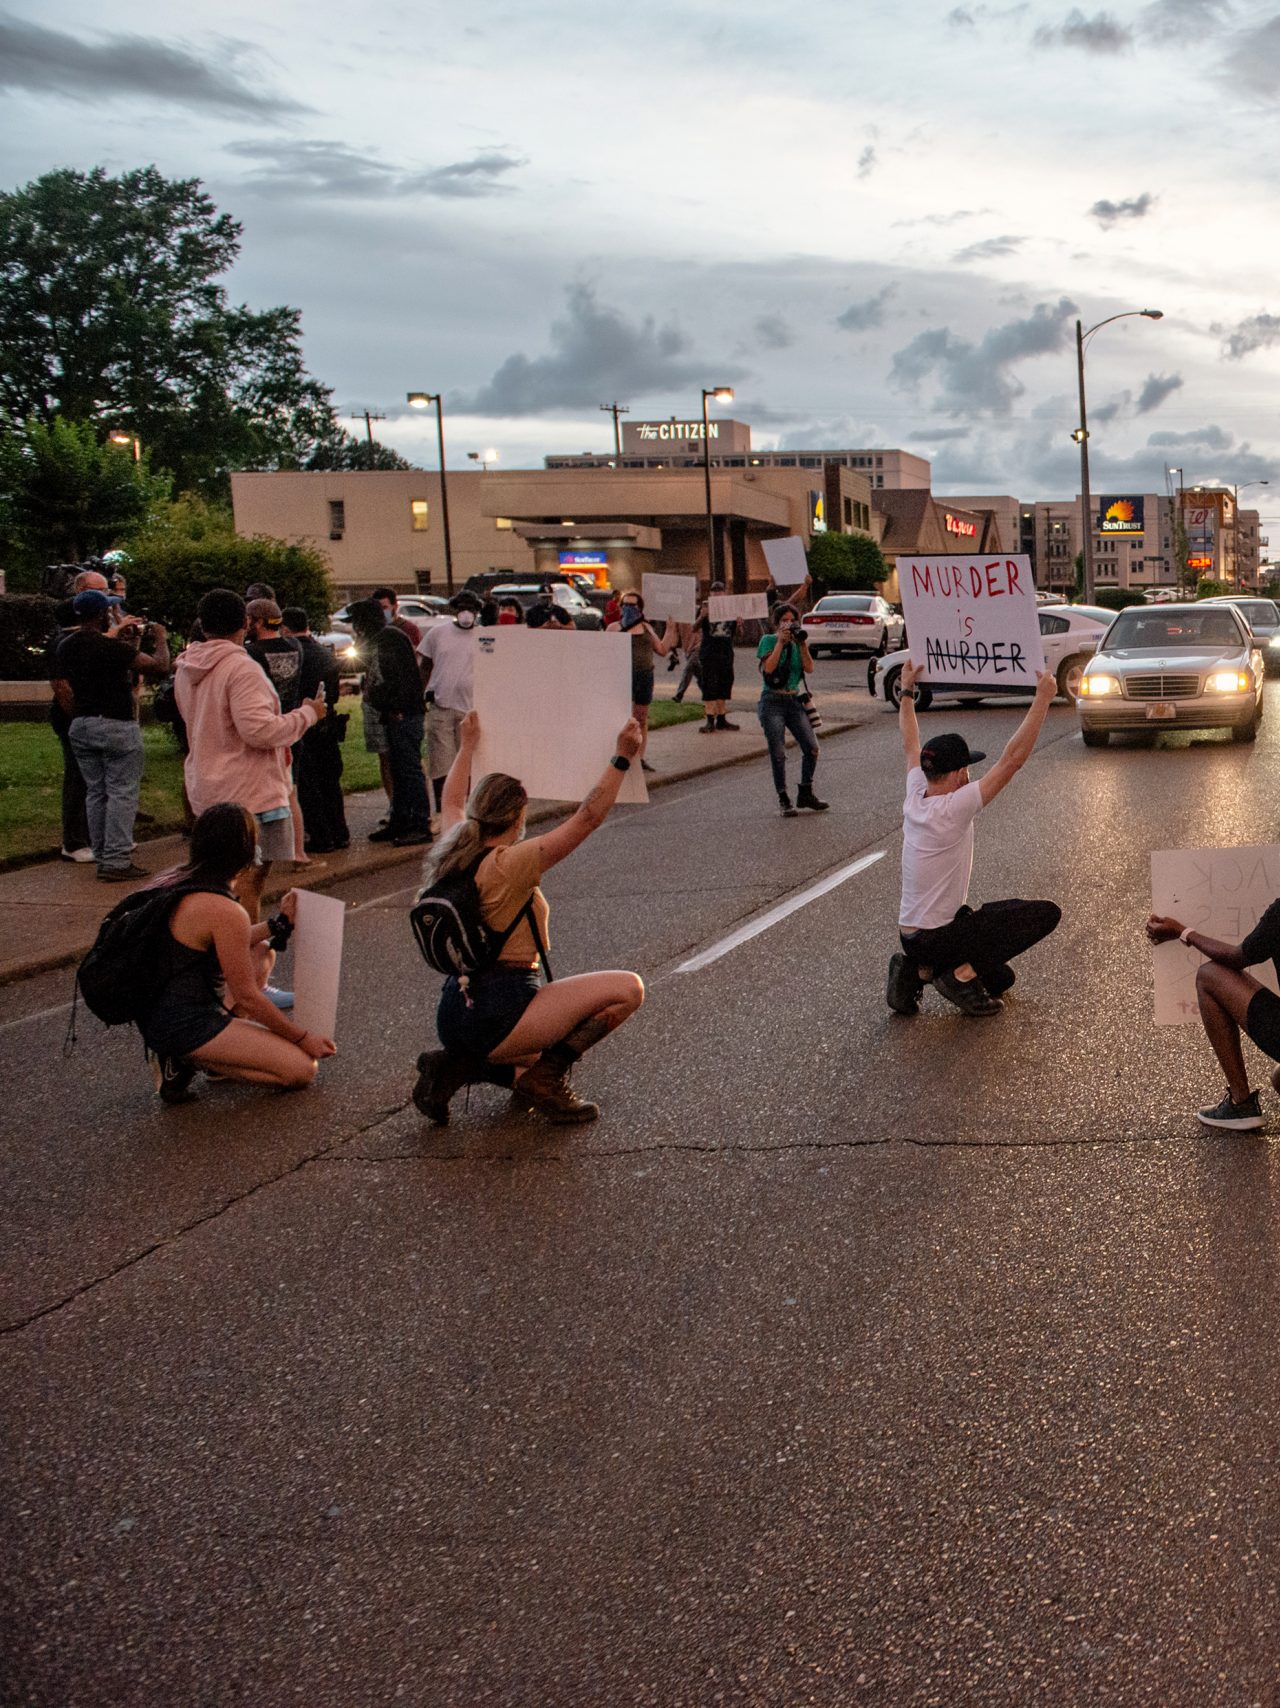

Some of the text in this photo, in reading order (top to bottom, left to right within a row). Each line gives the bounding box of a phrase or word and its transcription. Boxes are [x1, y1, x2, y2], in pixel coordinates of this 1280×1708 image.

[636, 423, 719, 440] the CITIZEN
[911, 560, 1026, 599] MURDER
[956, 608, 975, 637] is
[926, 637, 1027, 676] MURDER
